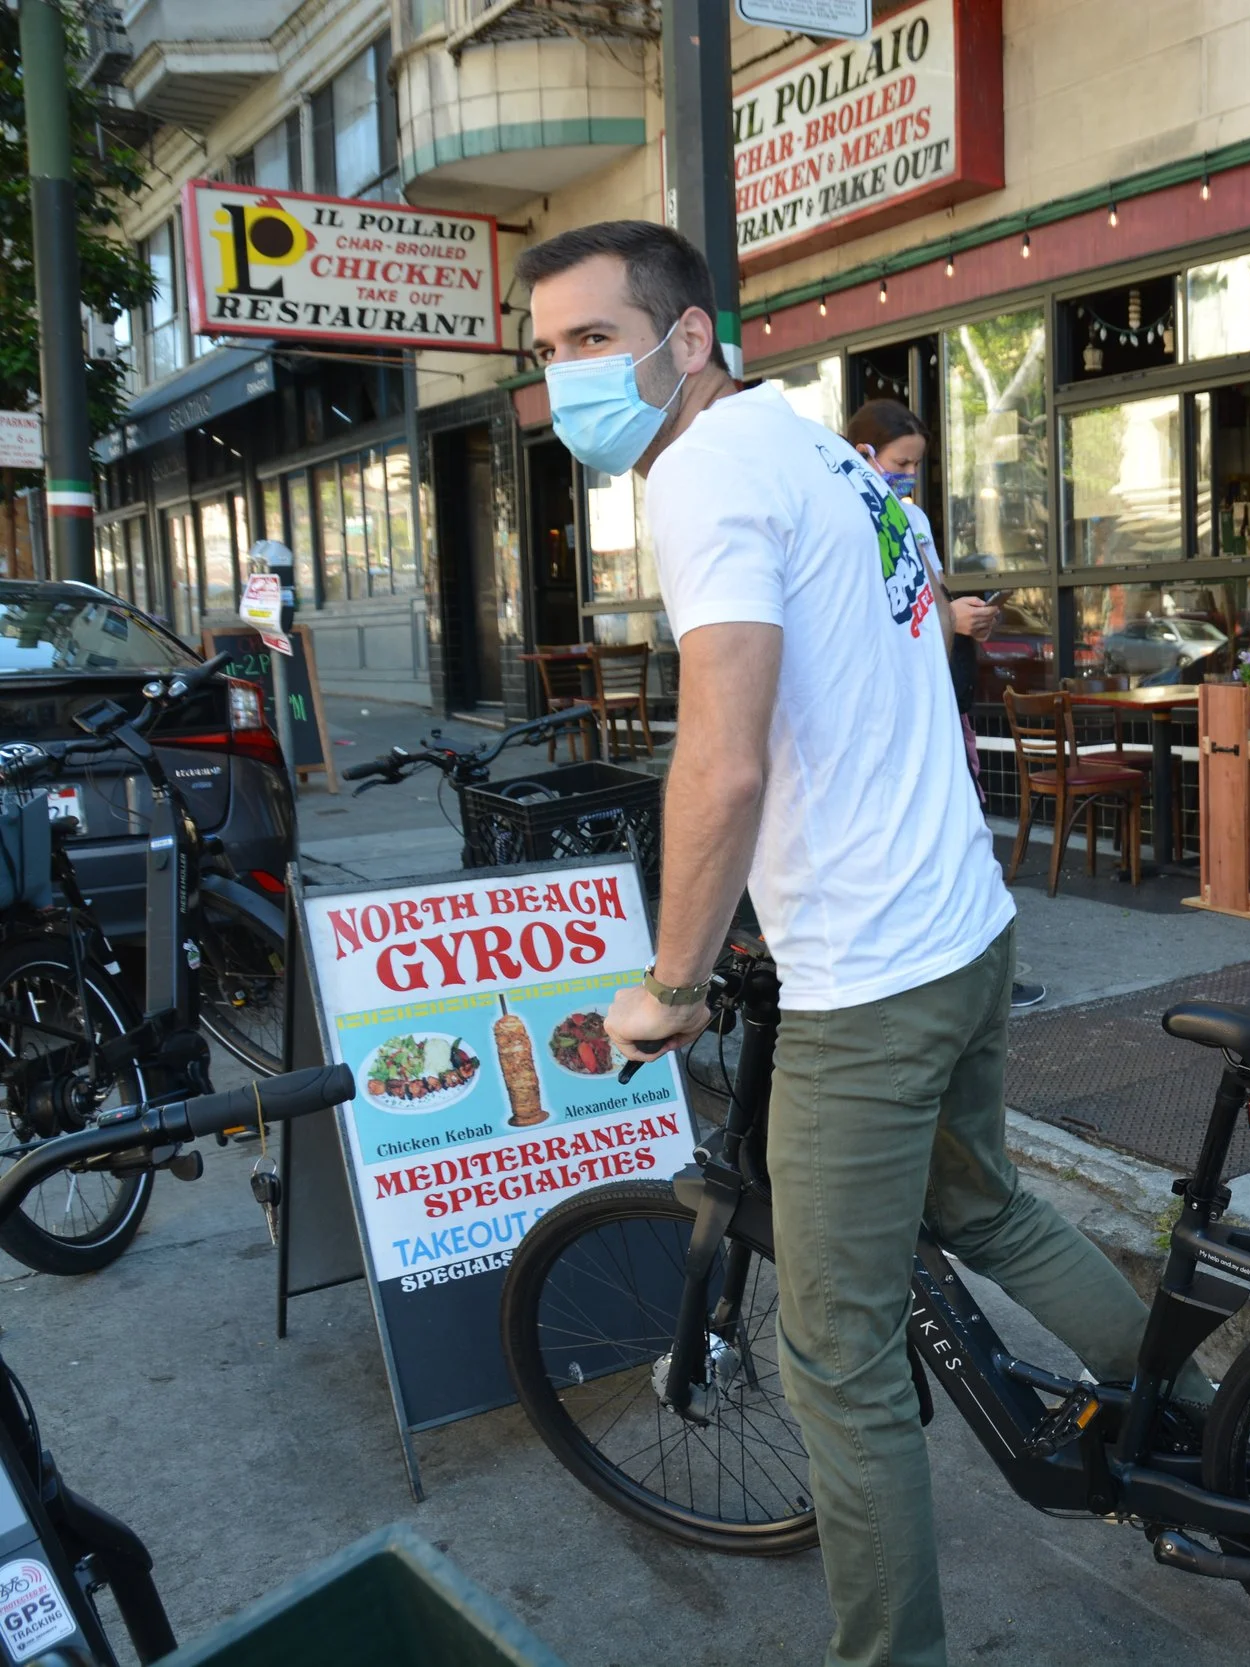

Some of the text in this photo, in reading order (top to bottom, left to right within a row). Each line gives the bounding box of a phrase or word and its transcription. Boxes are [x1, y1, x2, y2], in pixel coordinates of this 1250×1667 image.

[733, 16, 930, 144] IL POLLAIO
[736, 151, 824, 214] HICKEN
[839, 106, 932, 172] MEATS
[818, 164, 887, 216] TAKE
[893, 138, 949, 186] OUT
[312, 208, 476, 242] IL POLLAIO
[310, 254, 484, 290] CHICKEN
[212, 295, 485, 337] RESTAURANT
[356, 287, 444, 306] TAKE OUT
[327, 876, 627, 961] NORTH BEACH
[376, 920, 606, 992] GYROS
[564, 1087, 671, 1119] Alexander Kebab
[374, 1112, 680, 1200] MEDITERRANEAN
[376, 1123, 493, 1158] Chicken Kebab
[423, 1147, 656, 1218] SPECIALTIES
[392, 1210, 527, 1268] TAKEOUT
[1207, 1253, 1220, 1263] help
[400, 1250, 514, 1292] SPECIALS
[38, 1584, 49, 1595] BY
[4, 1593, 56, 1631] GPS
[11, 1610, 63, 1642] TRACKING
